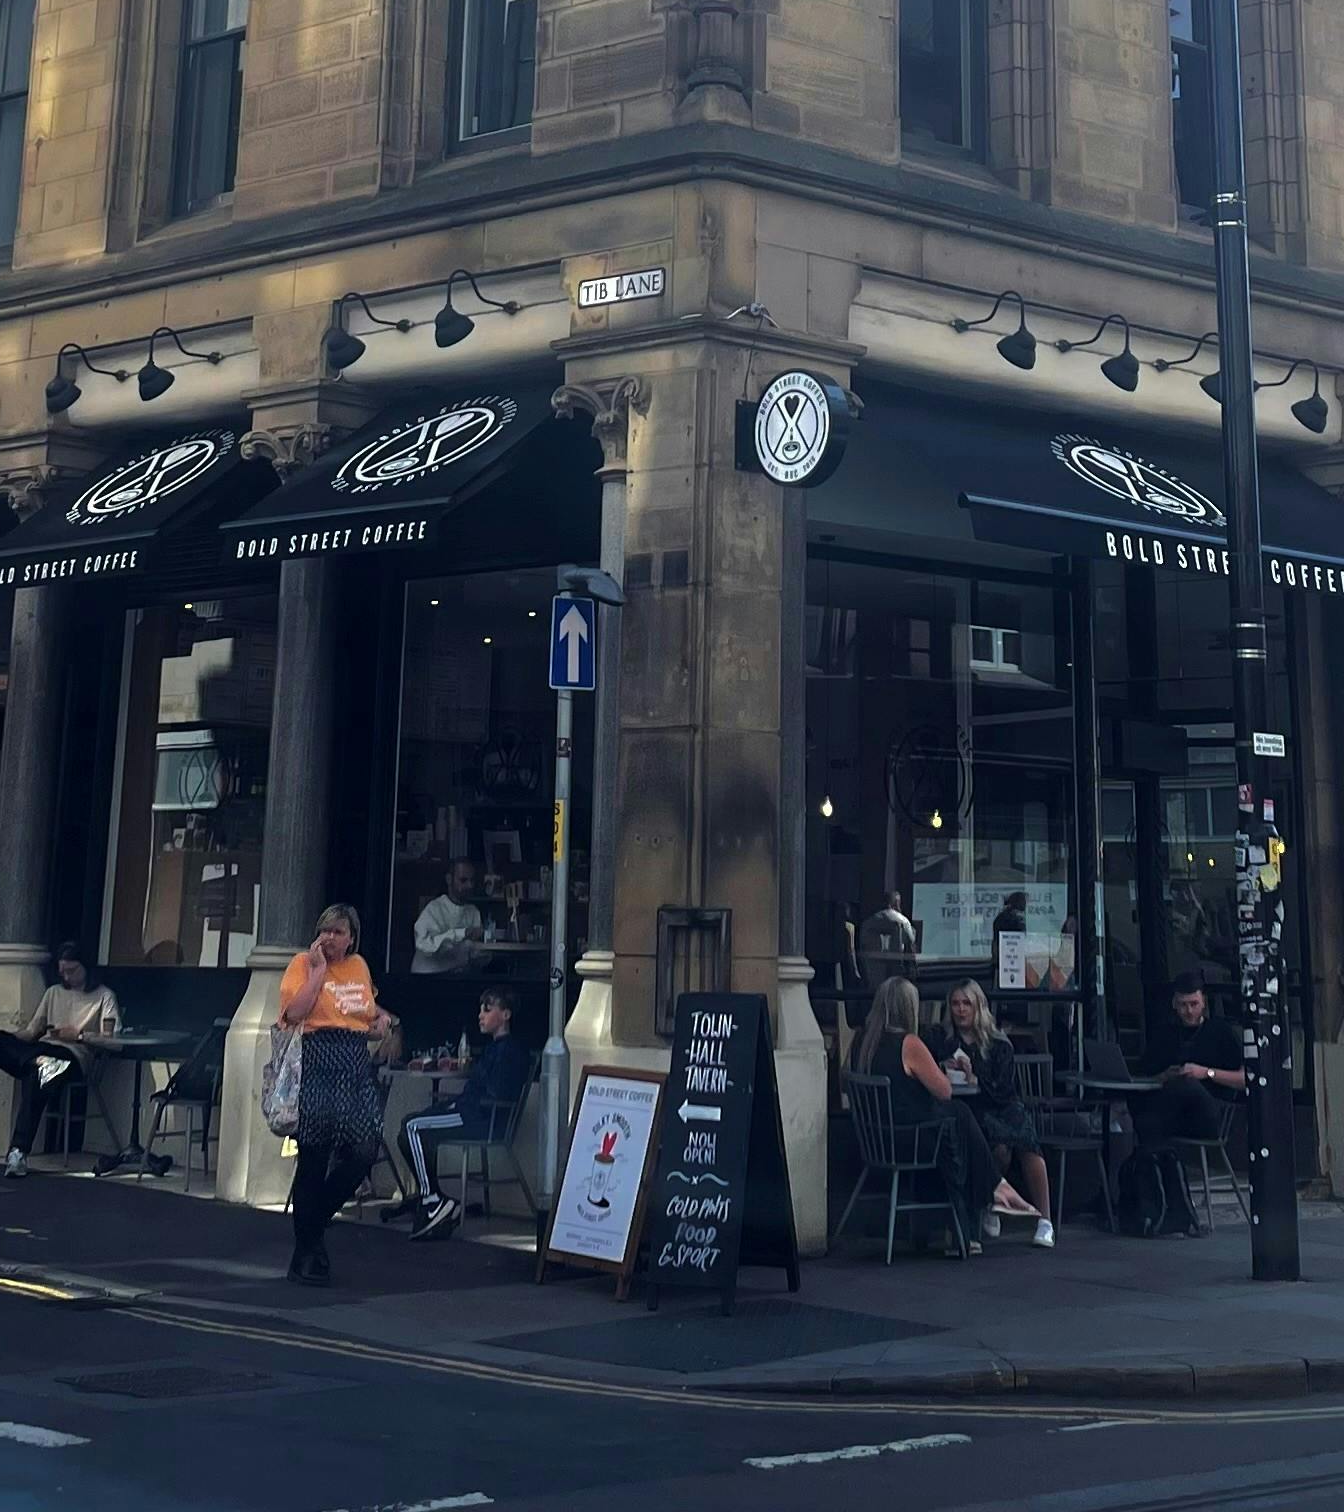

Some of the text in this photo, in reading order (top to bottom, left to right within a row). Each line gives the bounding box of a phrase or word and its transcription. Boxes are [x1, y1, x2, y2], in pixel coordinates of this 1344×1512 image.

[582, 273, 661, 303] TIB LANE
[775, 375, 801, 393] STREET
[236, 521, 428, 559] BOLD STREET COFFEE
[1106, 532, 1164, 566] BOLD
[1177, 544, 1230, 575] STRE
[23, 558, 77, 583] STREET
[84, 550, 138, 574] COFFEE
[688, 1131, 717, 1149] NOW
[666, 1194, 699, 1219] COLD
[675, 1221, 718, 1244] FOOD
